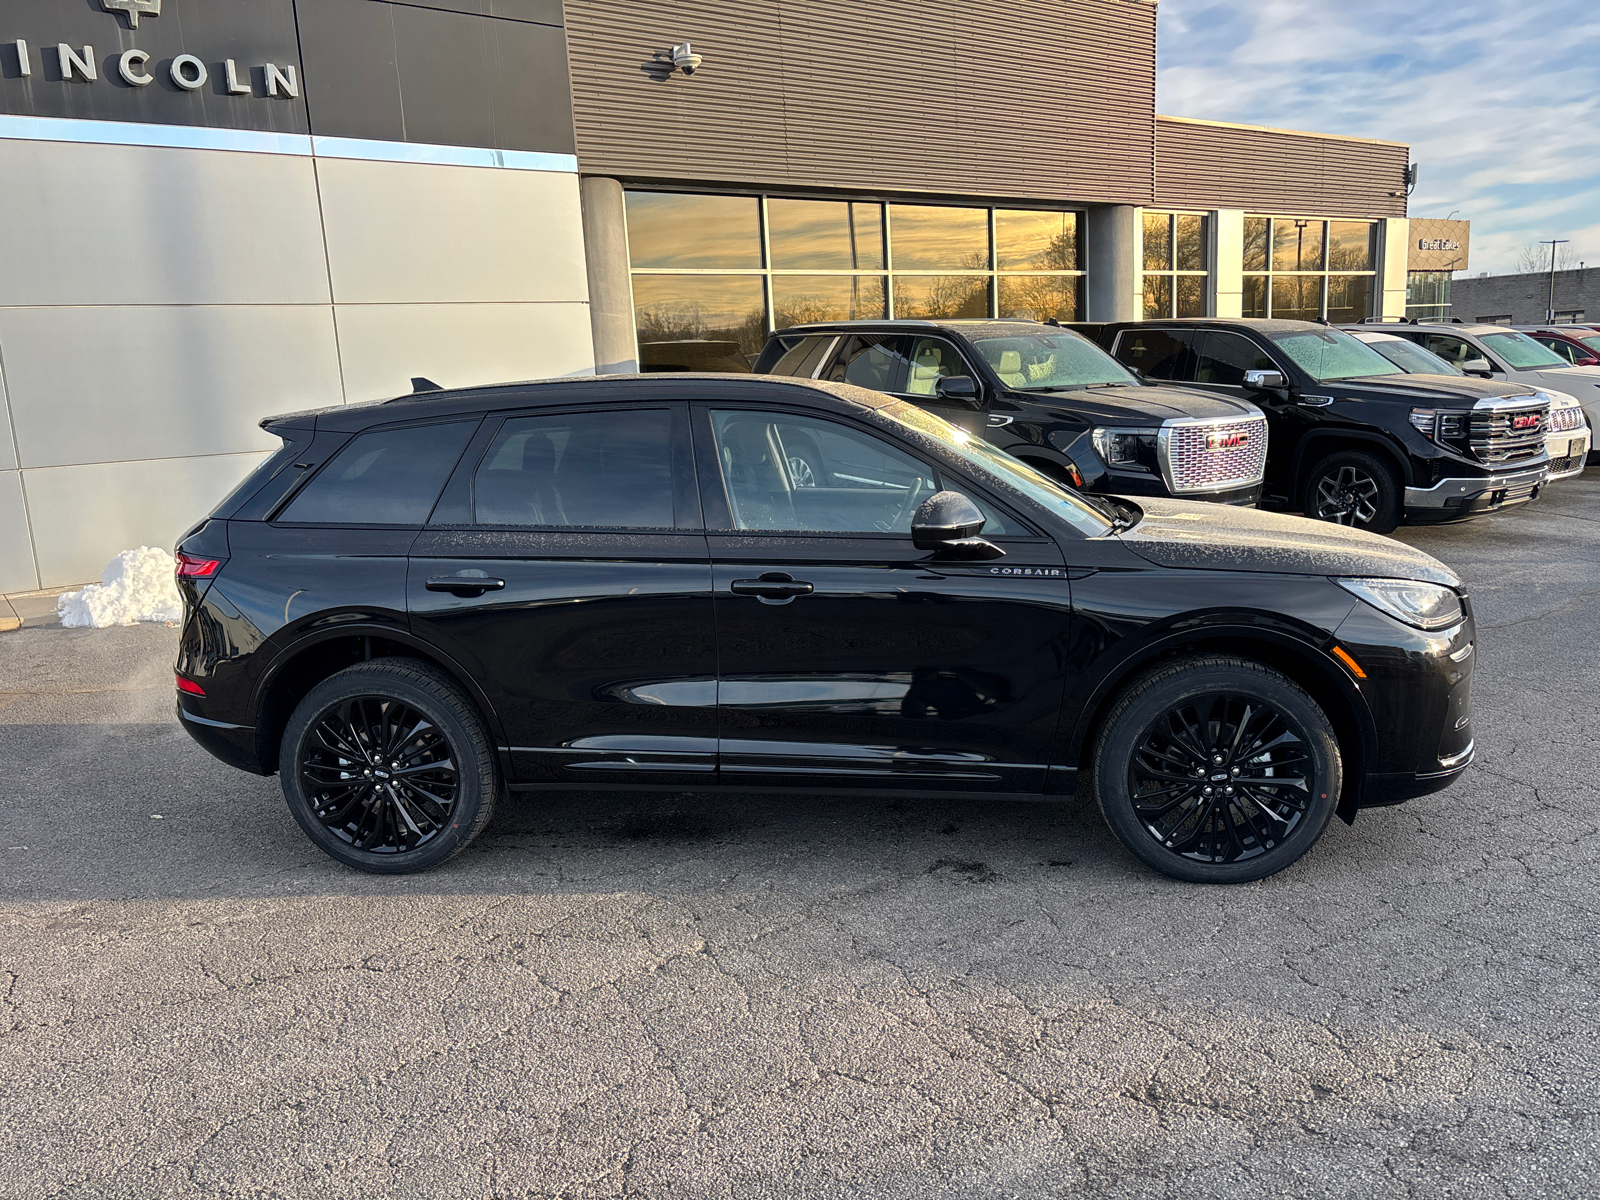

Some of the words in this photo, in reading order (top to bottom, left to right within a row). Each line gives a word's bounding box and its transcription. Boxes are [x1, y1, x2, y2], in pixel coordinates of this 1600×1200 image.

[1422, 238, 1440, 250] Great
[1442, 239, 1460, 251] Lakes
[1514, 415, 1541, 428] GMC
[990, 567, 1060, 576] CORSAIR
